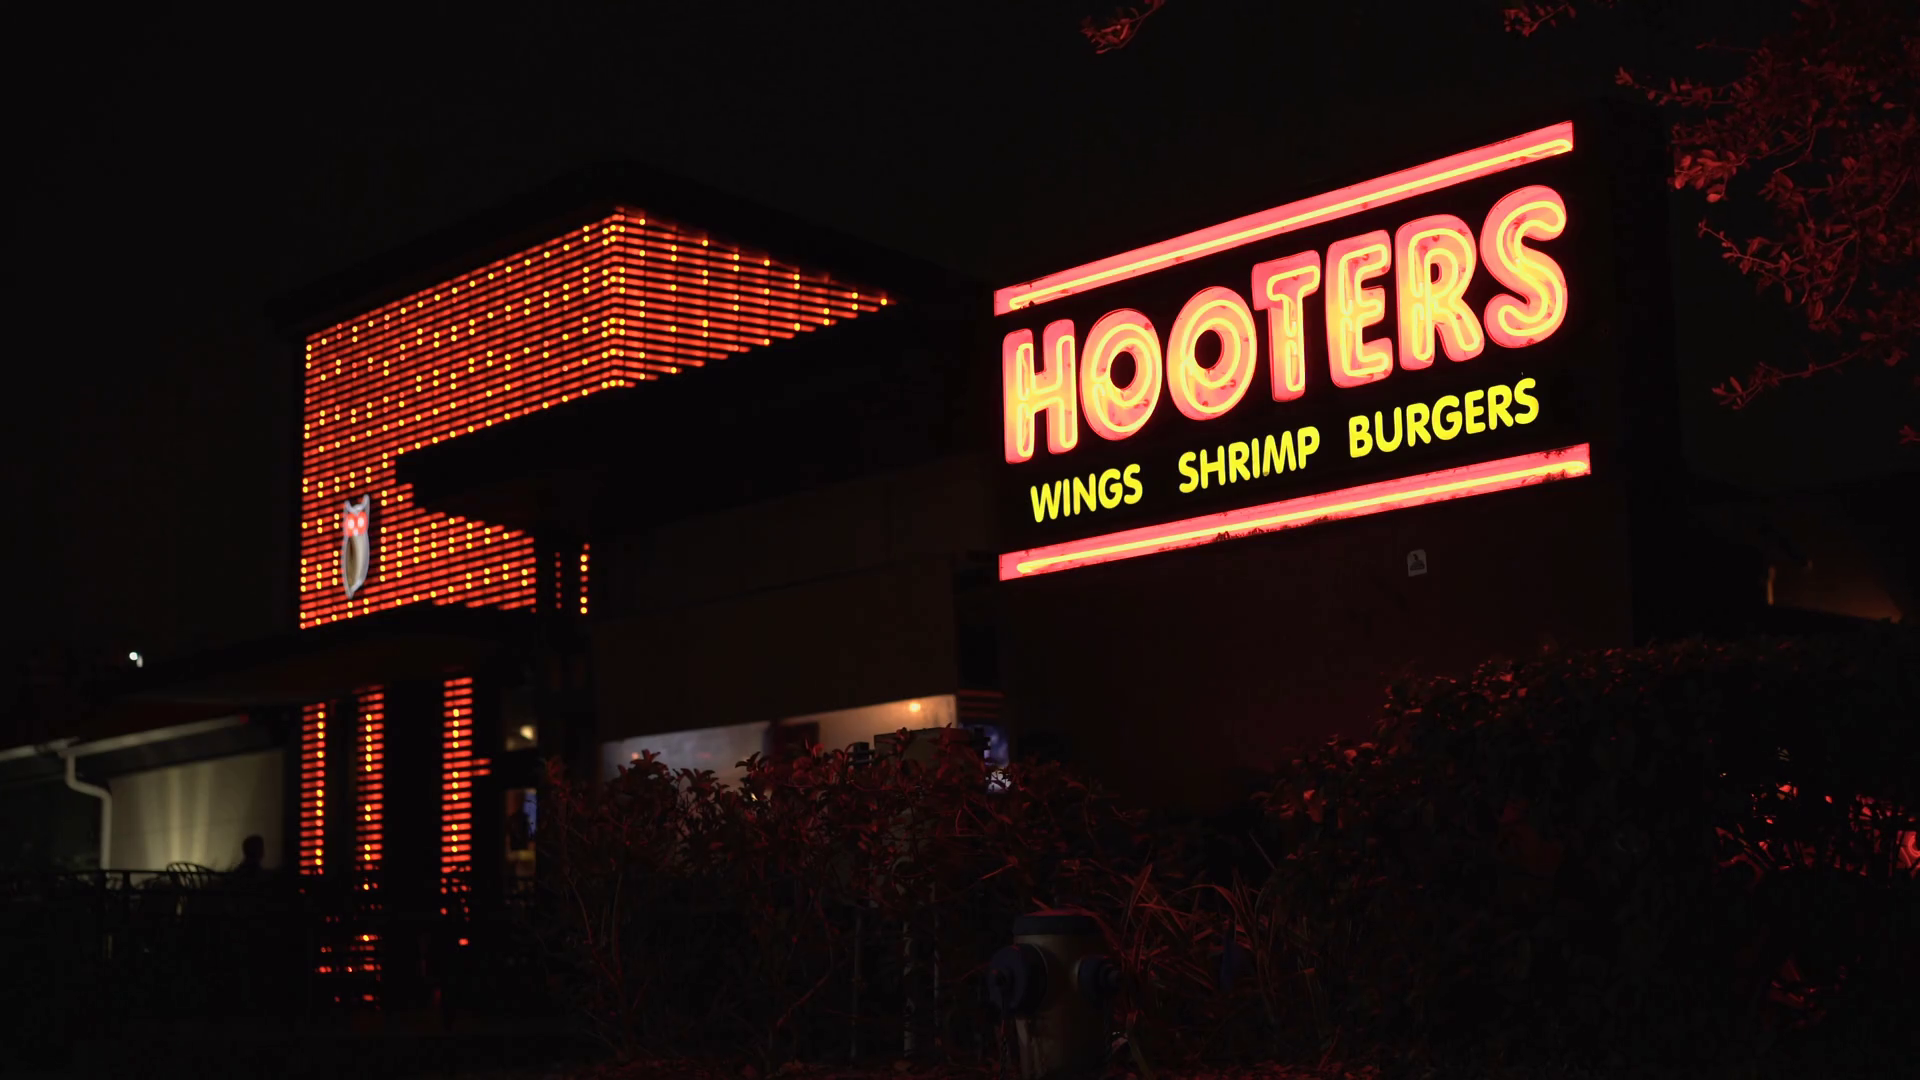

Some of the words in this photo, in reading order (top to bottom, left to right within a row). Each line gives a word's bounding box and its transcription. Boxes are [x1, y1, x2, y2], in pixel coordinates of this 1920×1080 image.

[1002, 184, 1569, 464] HOOTERS
[1030, 464, 1143, 523] WINGS
[1178, 426, 1321, 494] SHRIMP
[1348, 378, 1540, 459] BURGERS
